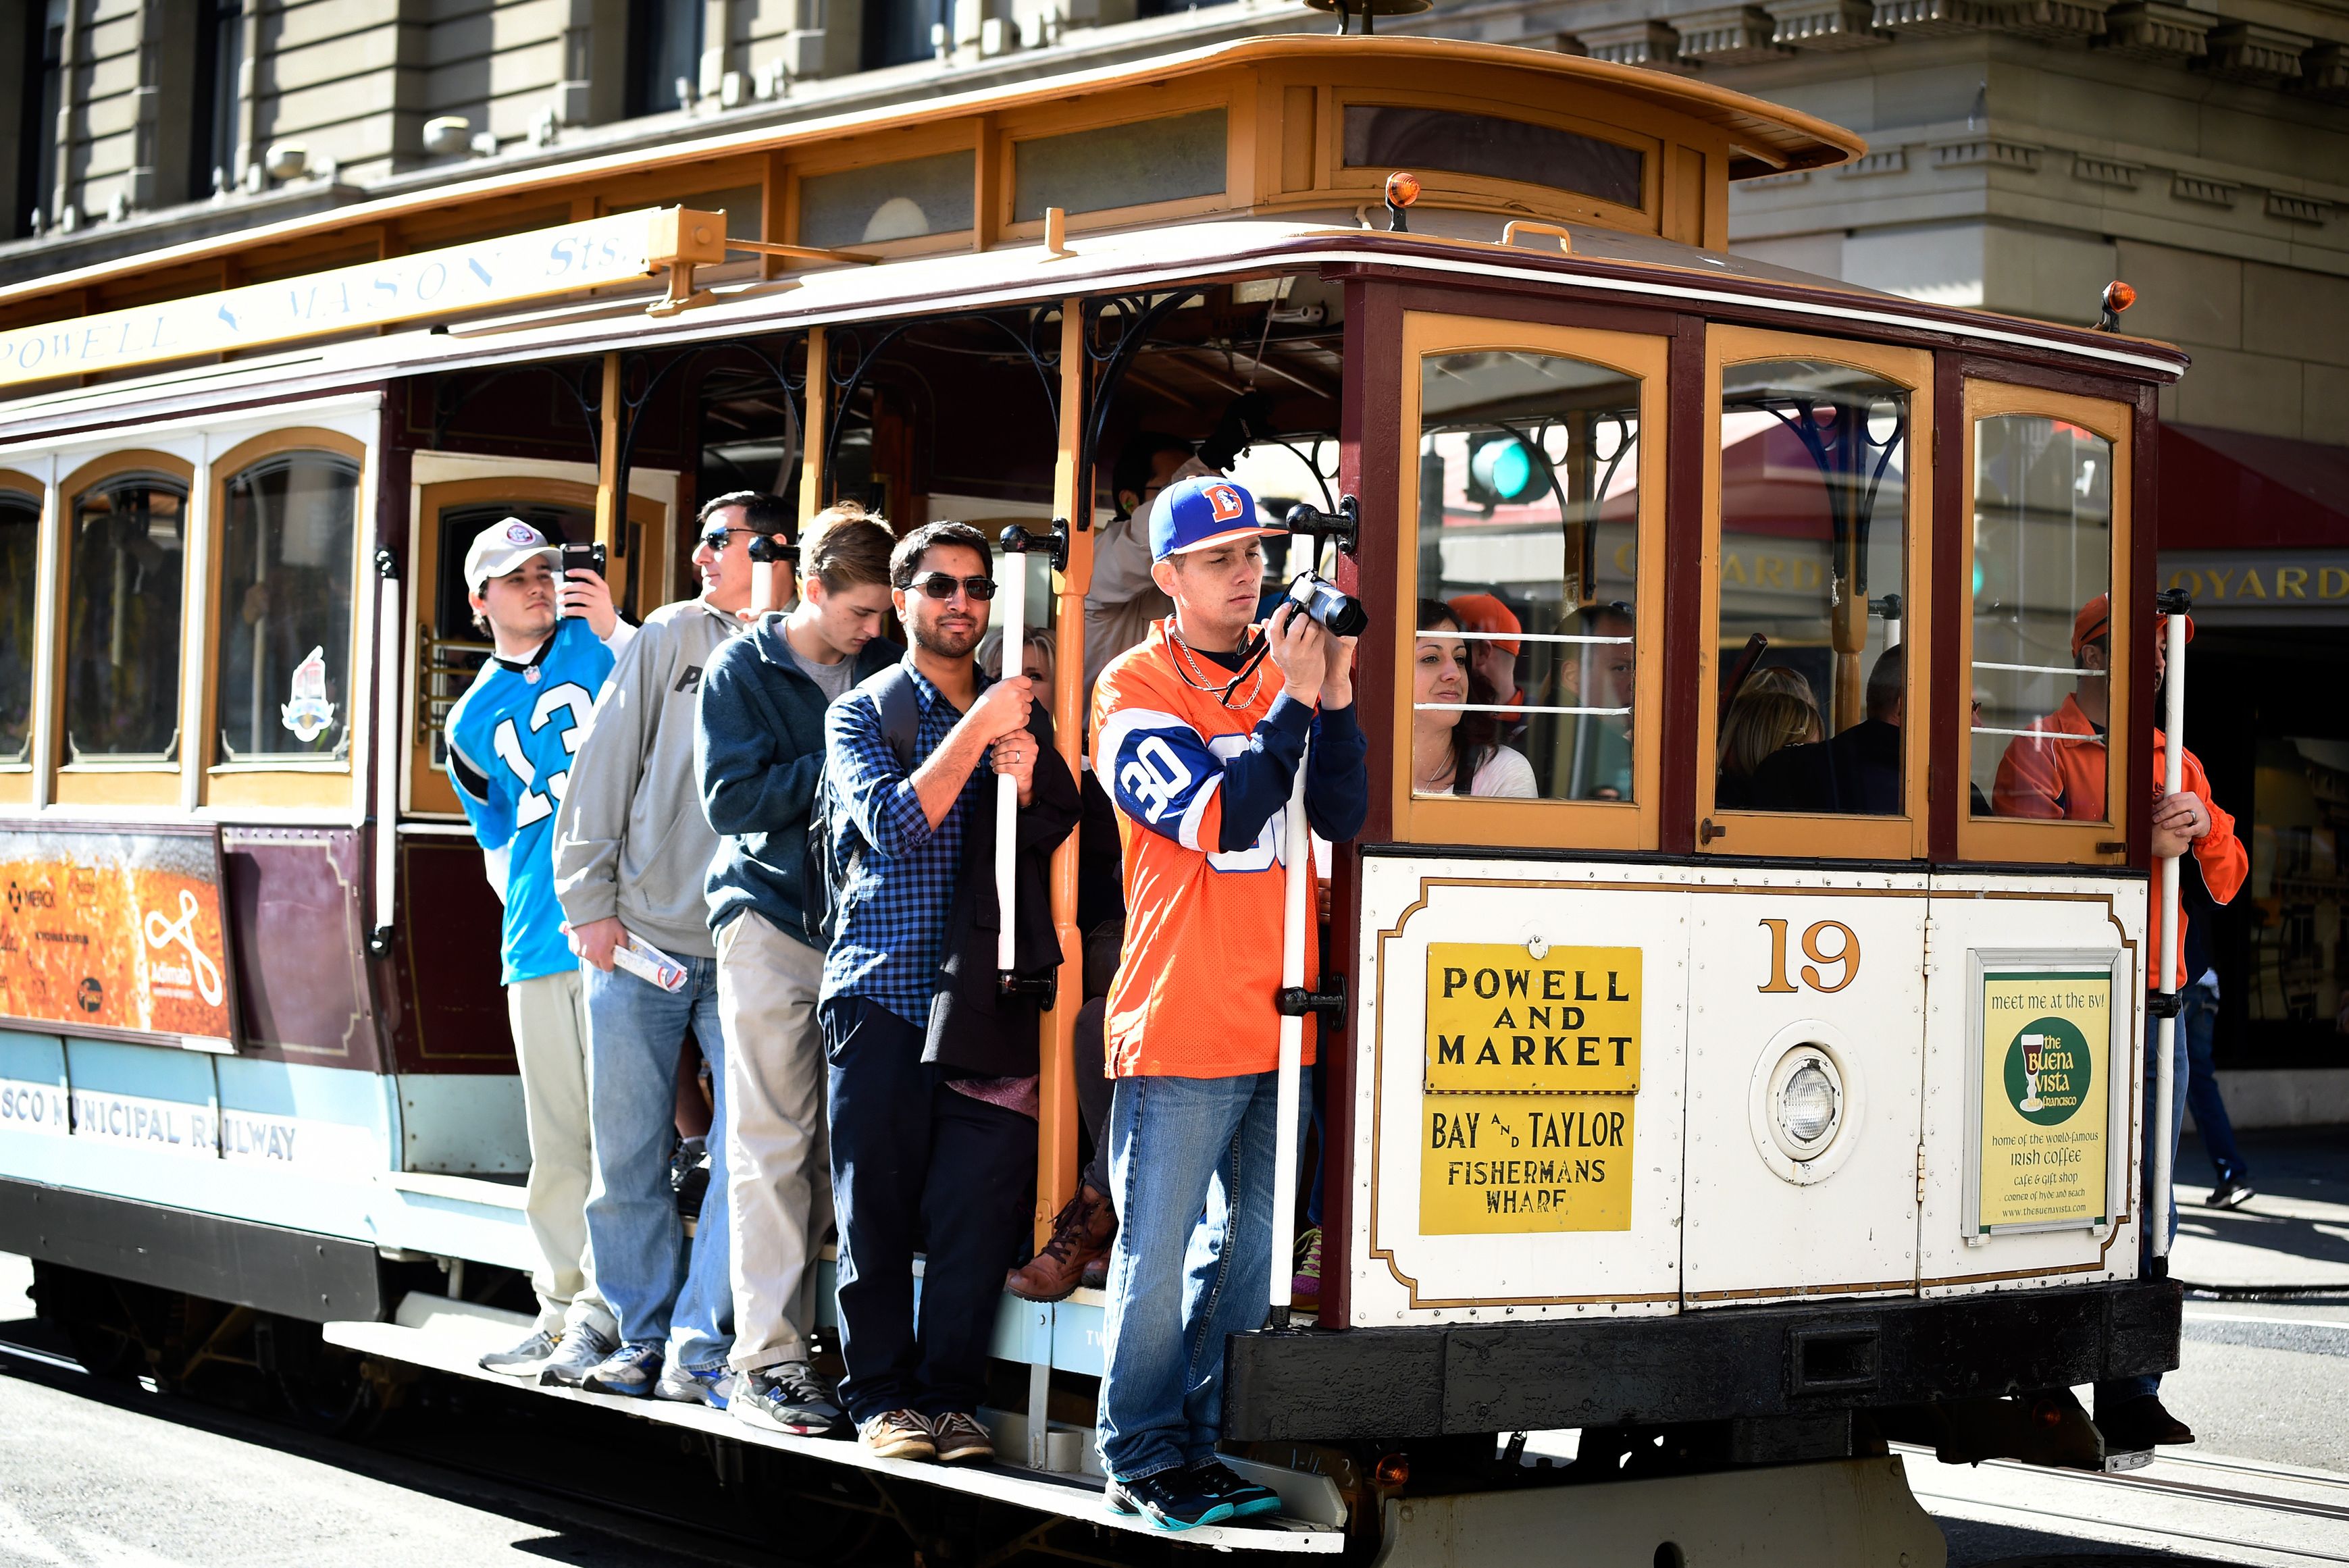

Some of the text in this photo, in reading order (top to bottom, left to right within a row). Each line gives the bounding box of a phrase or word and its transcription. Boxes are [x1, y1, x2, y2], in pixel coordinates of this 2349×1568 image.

[2157, 567, 2349, 600] OYARD
[493, 681, 594, 829] 13
[1120, 735, 1192, 825] 30
[1757, 918, 1861, 993] 19
[1441, 967, 1630, 1001] POWELL
[1992, 993, 2023, 1010] meet
[2028, 995, 2047, 1009] me
[2050, 993, 2063, 1009] at
[2065, 992, 2085, 1009] the
[1493, 1005, 1585, 1030] AND
[1437, 1035, 1632, 1066] MARKET
[2044, 1035, 2061, 1049] the
[2, 1087, 45, 1122] SCO
[1432, 1112, 1625, 1149] BAY AND TAYLOR
[1992, 1135, 2016, 1146] home
[2017, 1134, 2028, 1147] of
[2030, 1134, 2044, 1144] the
[1448, 1159, 1606, 1185] FISHERMANS
[2059, 1172, 2078, 1184] shop
[1486, 1188, 1566, 1213] WHARF
[2030, 1191, 2038, 1201] of
[2055, 1189, 2067, 1198] and
